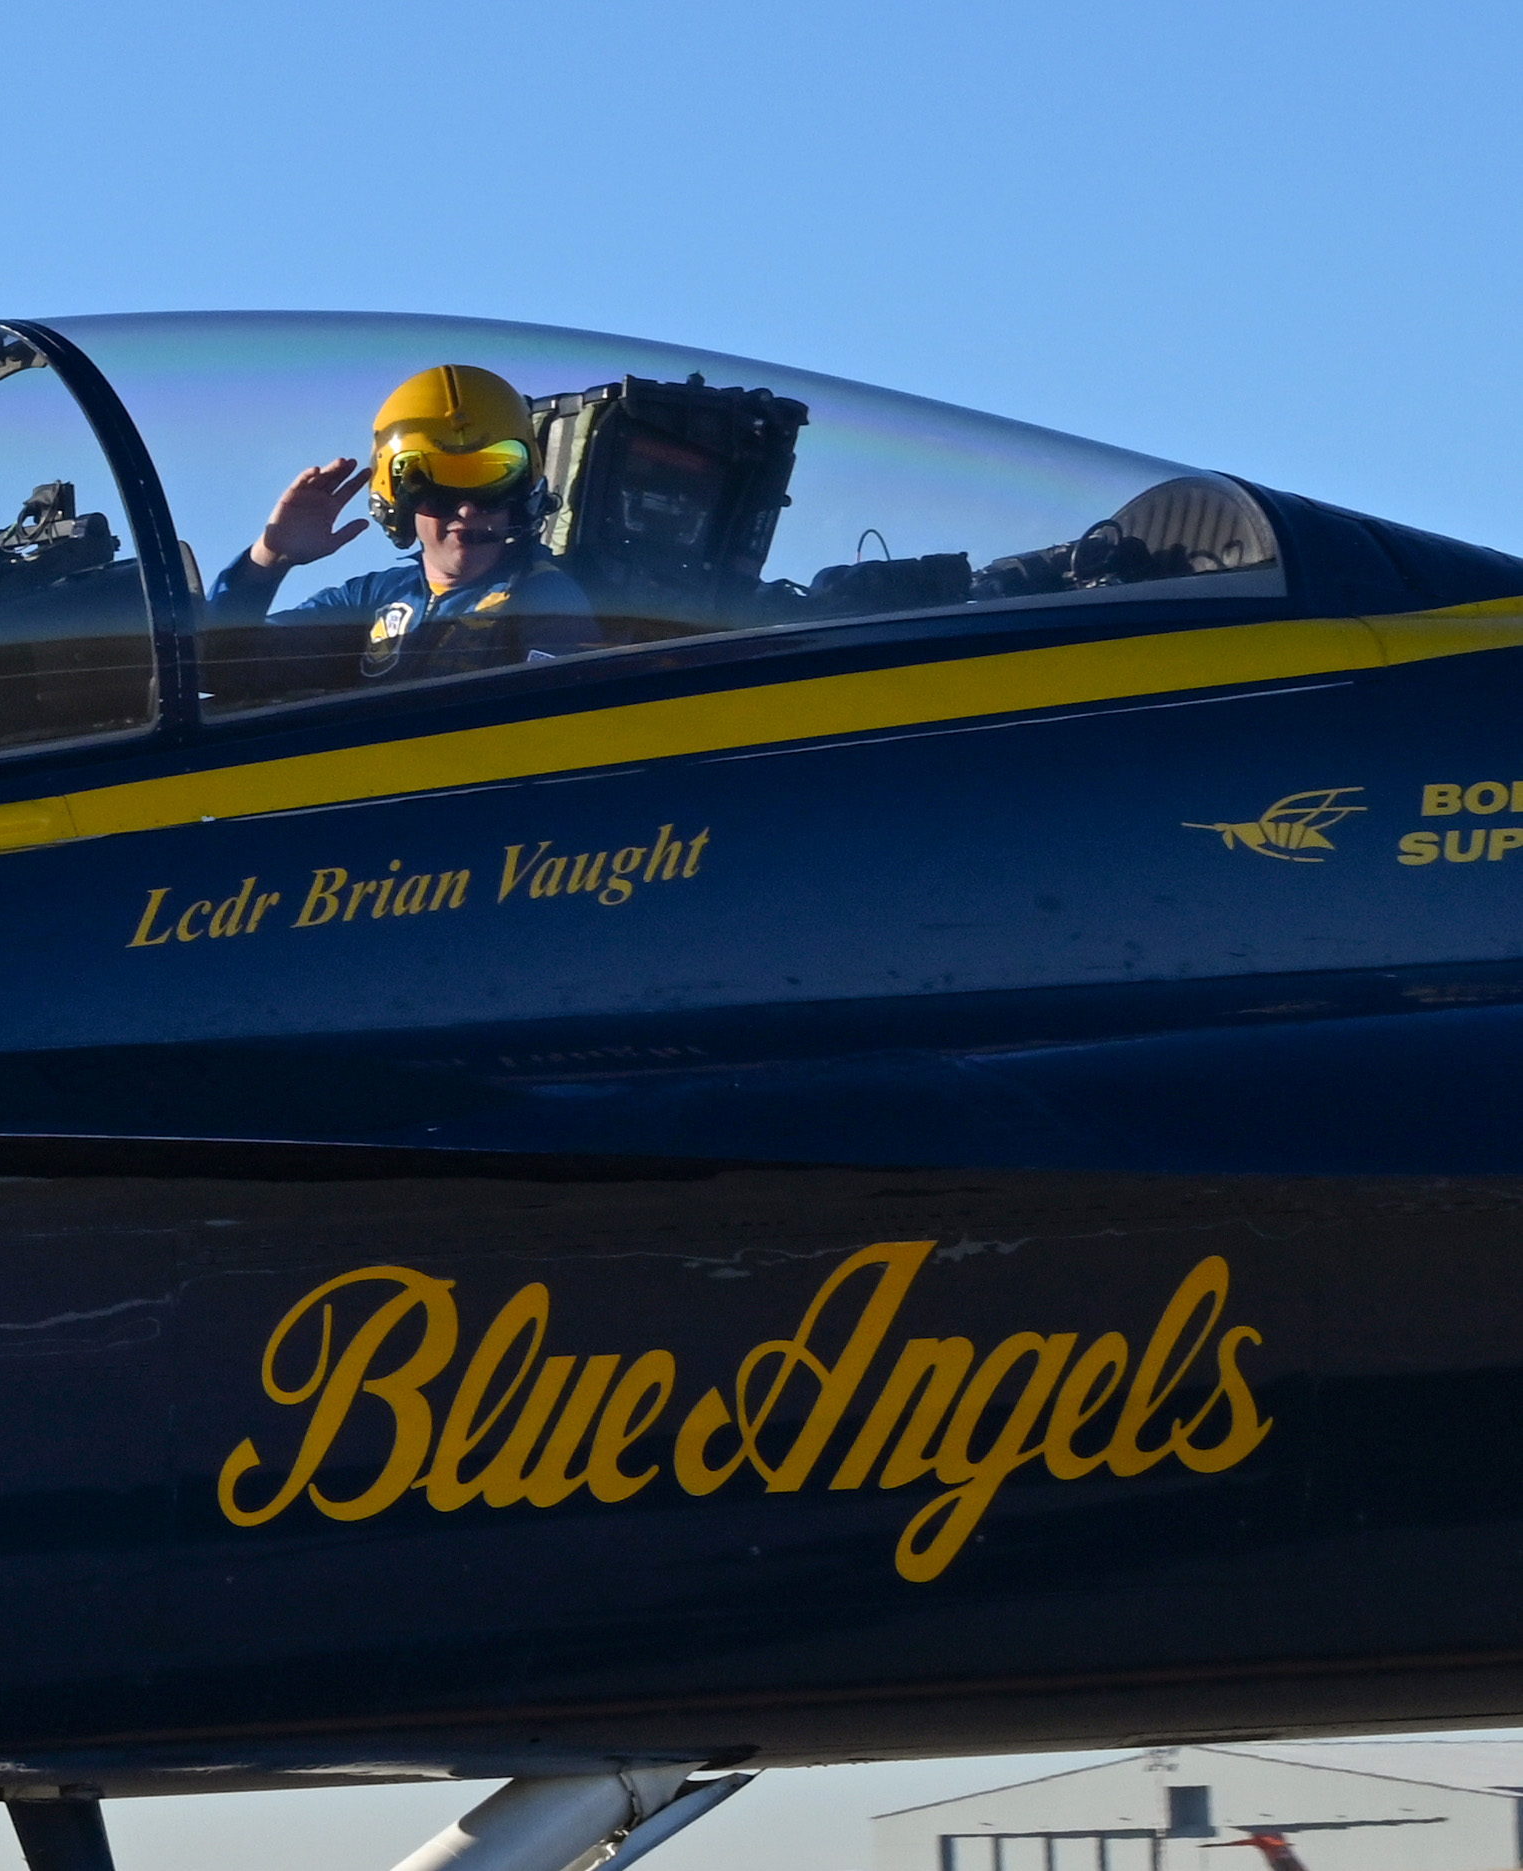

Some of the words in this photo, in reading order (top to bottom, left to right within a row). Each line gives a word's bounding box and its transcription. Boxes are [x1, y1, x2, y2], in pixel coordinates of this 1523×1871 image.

[127, 876, 281, 948] Lcdr
[291, 859, 471, 929] Brian
[497, 822, 711, 905] Vaught
[218, 1264, 677, 1527] Blue
[674, 1239, 1275, 1583] Angels
